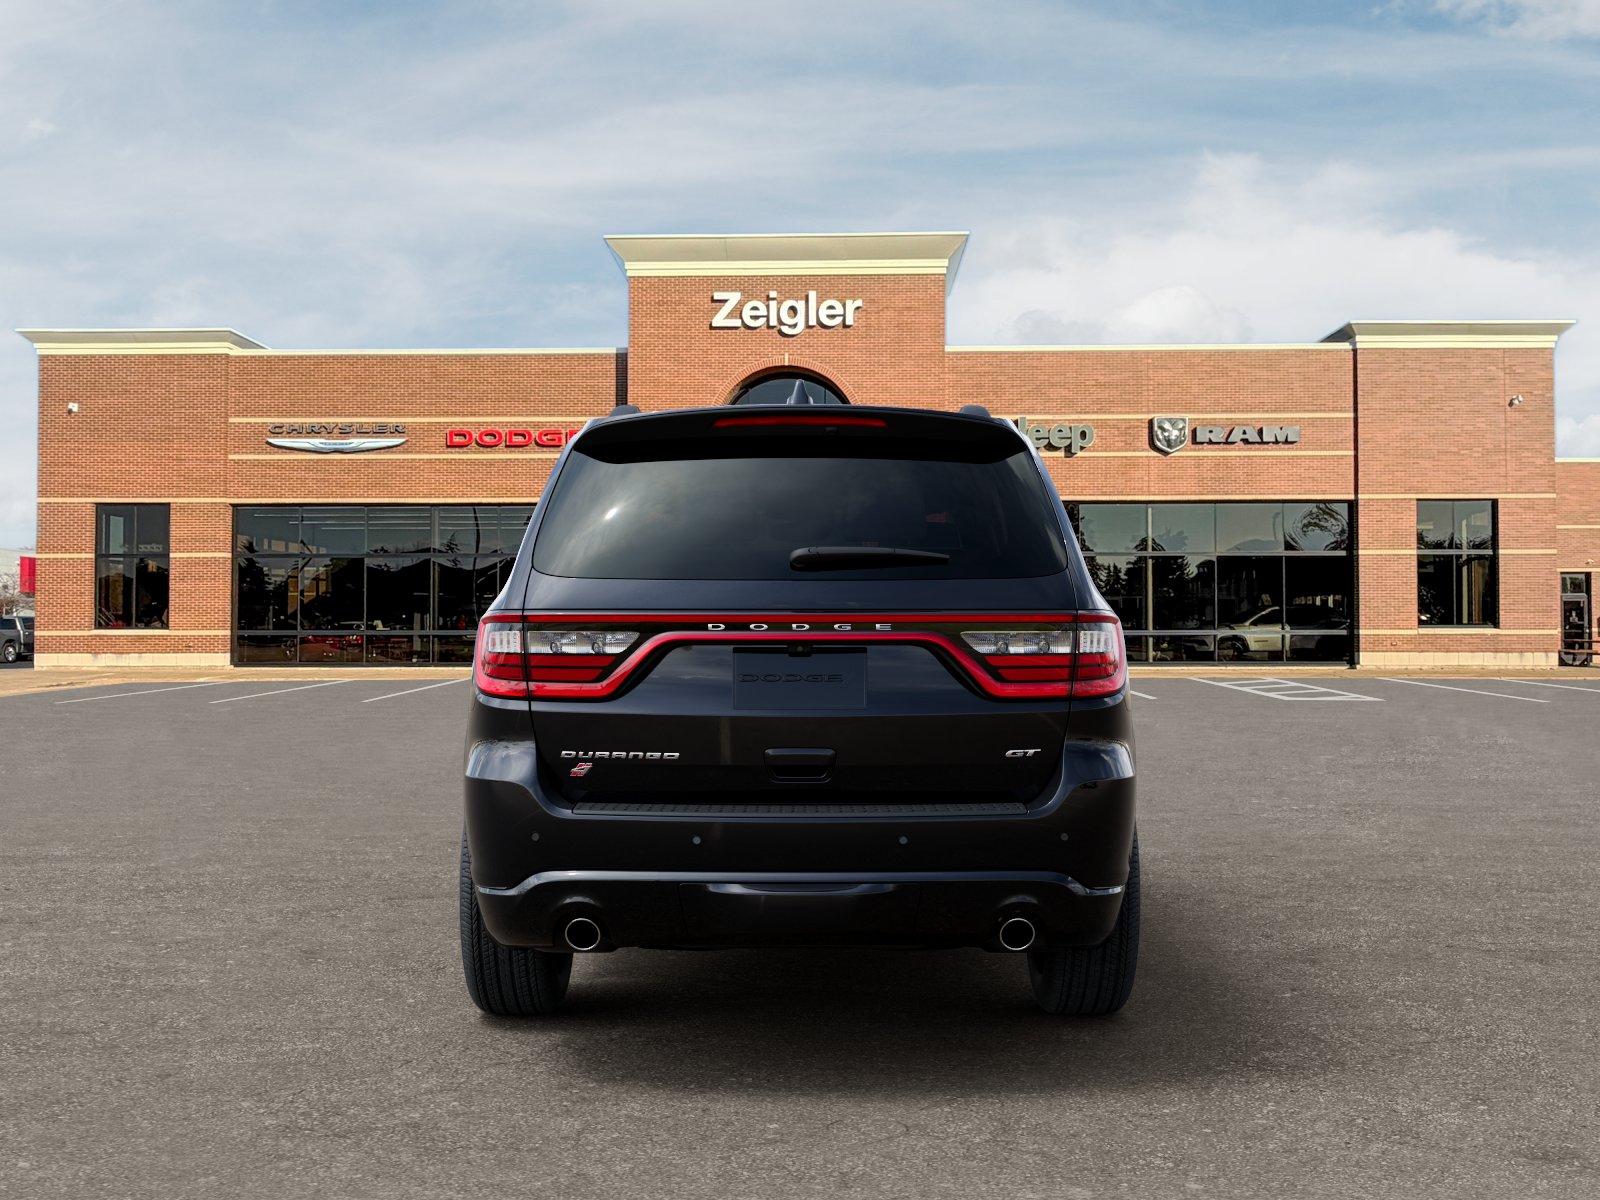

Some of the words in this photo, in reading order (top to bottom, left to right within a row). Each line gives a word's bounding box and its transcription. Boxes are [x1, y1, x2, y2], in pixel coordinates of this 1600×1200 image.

[711, 291, 863, 335] Zeigler
[269, 423, 406, 434] CHRYSLER
[1195, 425, 1300, 443] RAM
[707, 623, 892, 631] DODGE
[738, 674, 844, 683] DODGE
[560, 750, 680, 760] DURANGO
[1005, 748, 1042, 758] GT
